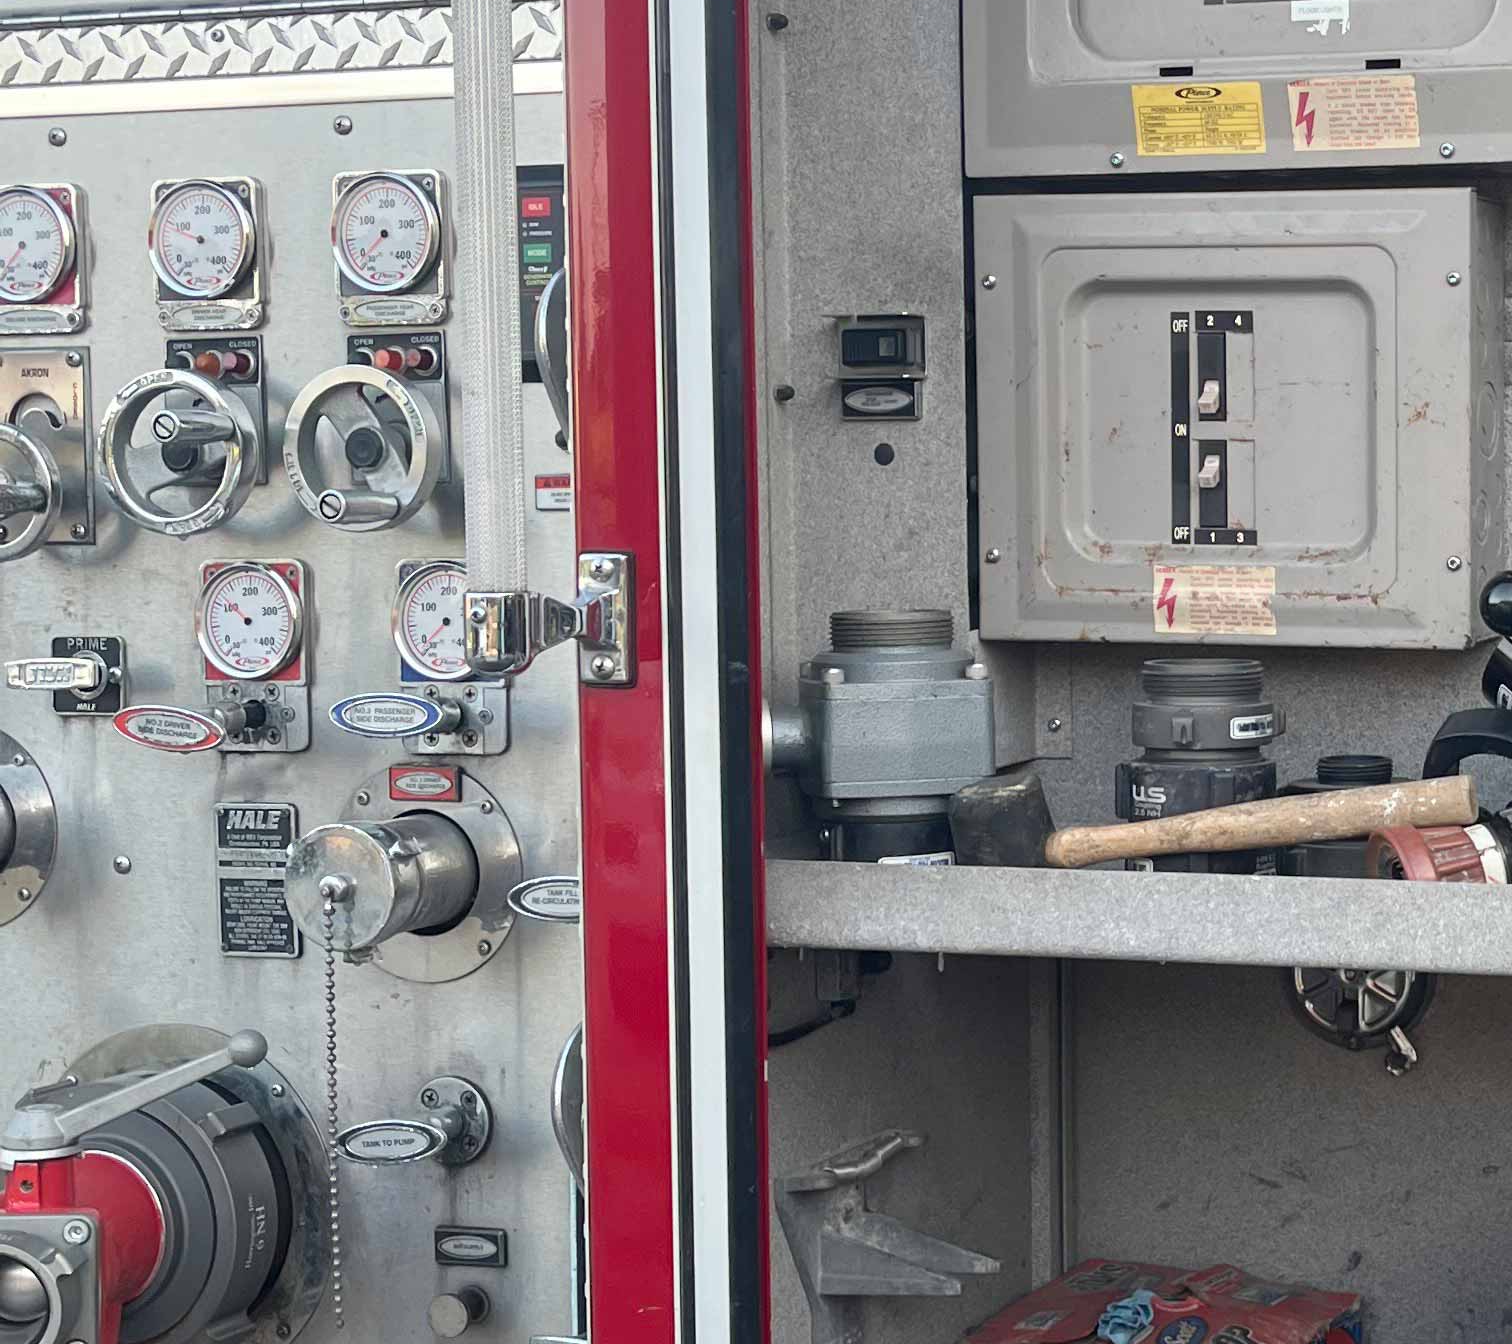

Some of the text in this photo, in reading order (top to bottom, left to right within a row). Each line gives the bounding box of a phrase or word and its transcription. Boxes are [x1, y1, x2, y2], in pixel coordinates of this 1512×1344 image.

[378, 199, 395, 208] 200
[528, 203, 543, 211] IDLE
[194, 206, 211, 215] 200
[16, 211, 32, 220] 200
[359, 216, 374, 225] 100
[399, 219, 415, 229] 300
[176, 222, 190, 231] 100
[214, 225, 229, 234] 300
[36, 230, 50, 239] 300
[360, 250, 366, 258] 0
[395, 250, 411, 260] 400
[177, 255, 182, 264] 0
[211, 256, 227, 265] 400
[33, 261, 48, 270] 400
[1207, 315, 1214, 325] 2
[1235, 315, 1242, 325] 4
[1173, 320, 1188, 333] OFF
[229, 340, 257, 348] CLOSED
[354, 338, 374, 346] OPEN
[410, 336, 440, 344] CLOSED
[173, 343, 192, 351] OPEN
[21, 368, 49, 377] AKRON
[1175, 425, 1187, 437] ON
[1174, 527, 1189, 540] OFF
[1210, 533, 1216, 542] 1
[1237, 533, 1244, 542] 3
[242, 587, 259, 596] 200
[441, 587, 458, 596] 200
[224, 603, 239, 613] 100
[262, 607, 278, 616] 300
[421, 603, 437, 612] 100
[225, 635, 230, 644] 0
[260, 637, 275, 646] 400
[422, 635, 427, 644] 0
[67, 638, 107, 651] PRIME
[76, 703, 96, 711] HALE
[375, 708, 415, 716] PASSENGER
[164, 720, 191, 730] DRIVER
[156, 728, 197, 739] DISCHARGE
[1132, 784, 1167, 804] US
[1134, 808, 1145, 816] 2.5
[226, 810, 281, 830] HALE
[362, 1138, 415, 1148] TANK TO PUMP
[255, 1206, 265, 1235] NH
